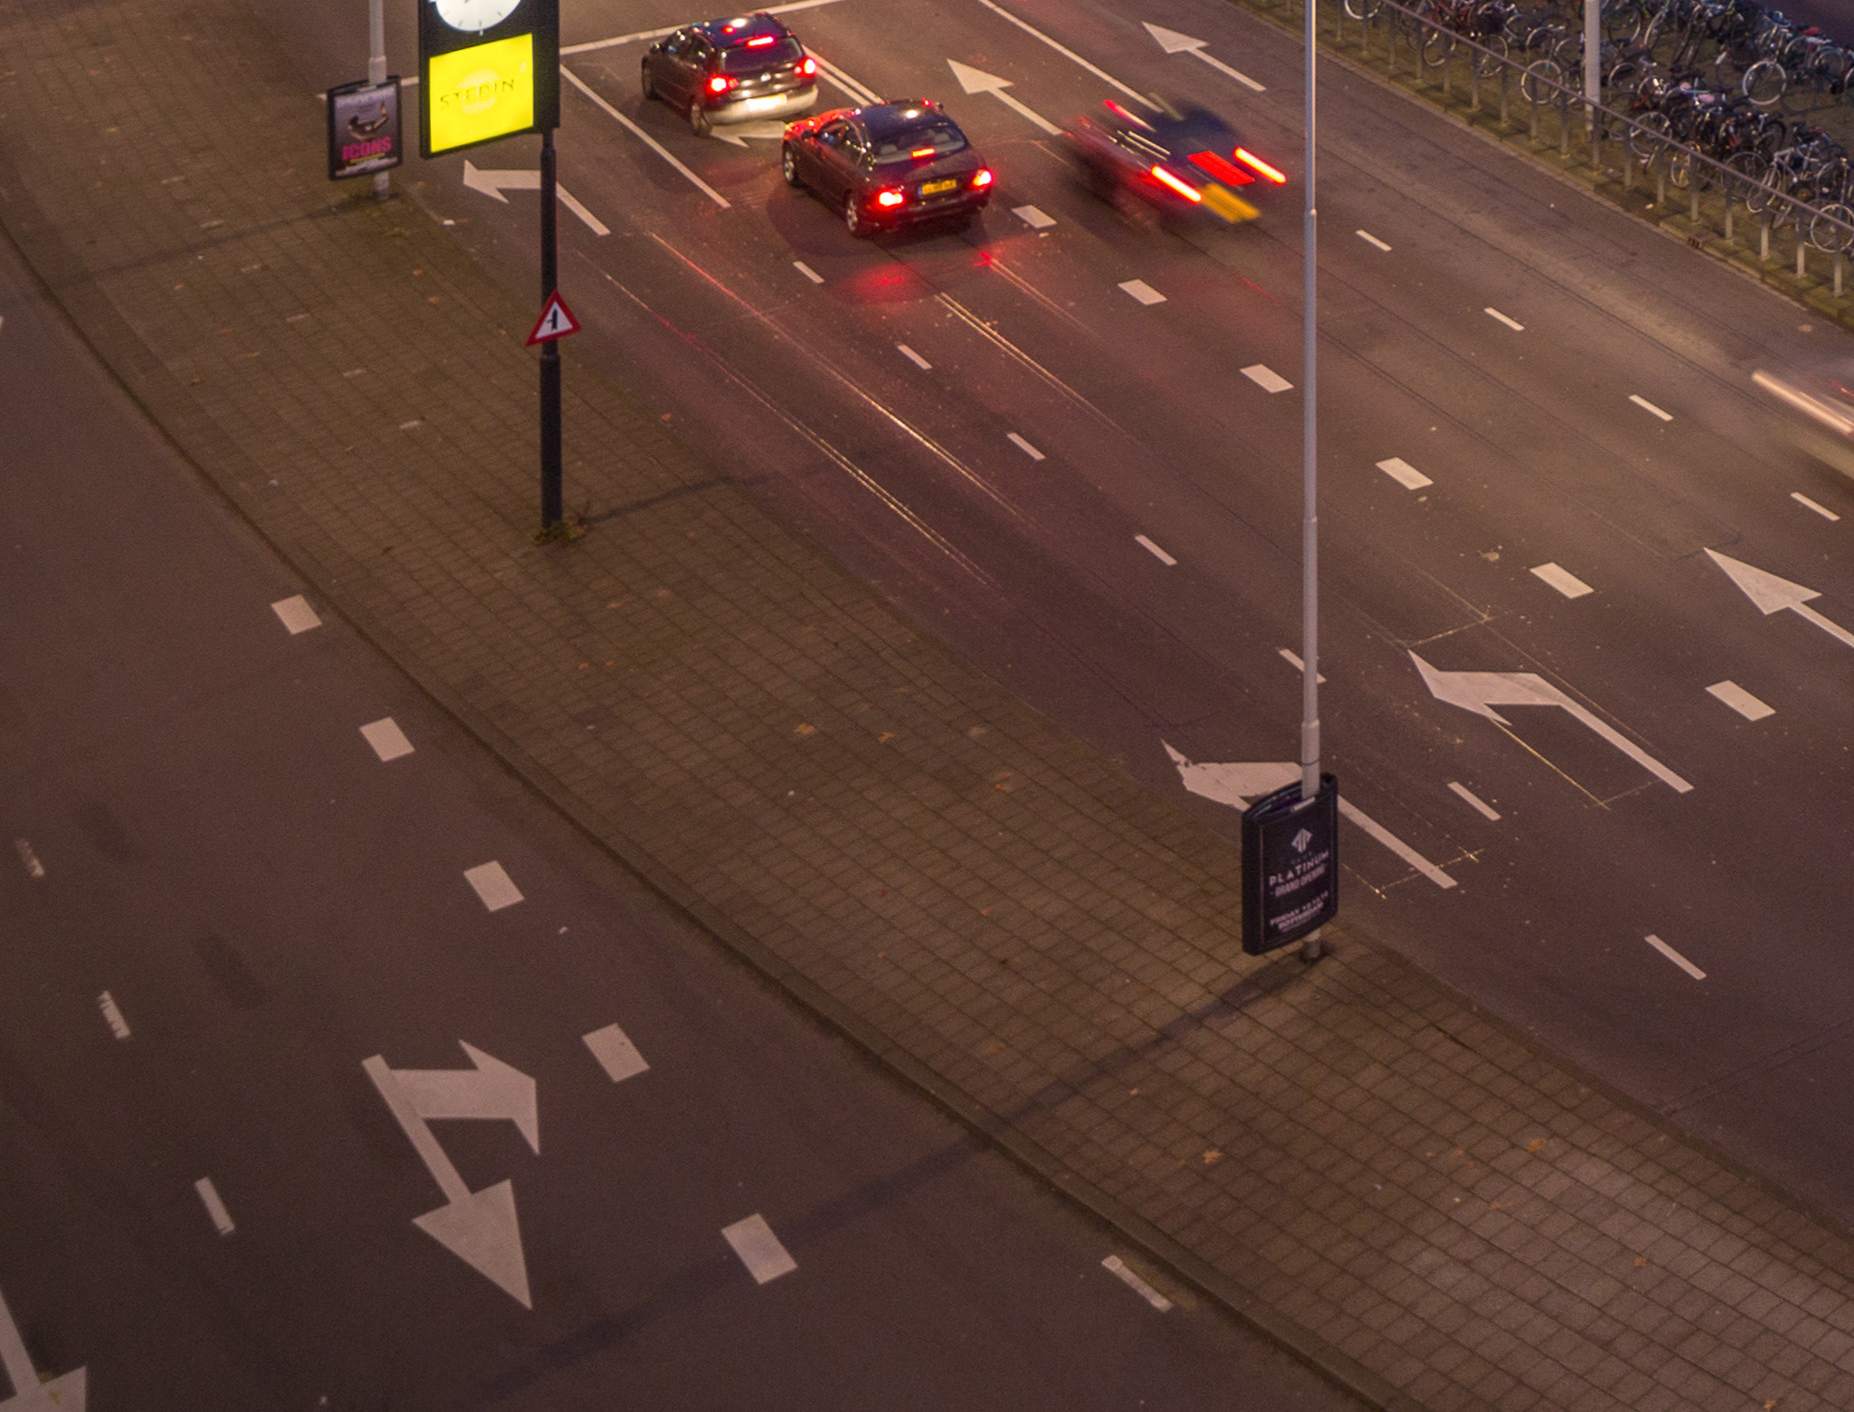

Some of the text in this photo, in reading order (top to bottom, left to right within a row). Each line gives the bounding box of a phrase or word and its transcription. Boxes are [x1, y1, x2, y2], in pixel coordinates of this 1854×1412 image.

[440, 78, 515, 112] STEDIN
[342, 135, 393, 161] ICONS
[1268, 848, 1330, 887] PLATINUM
